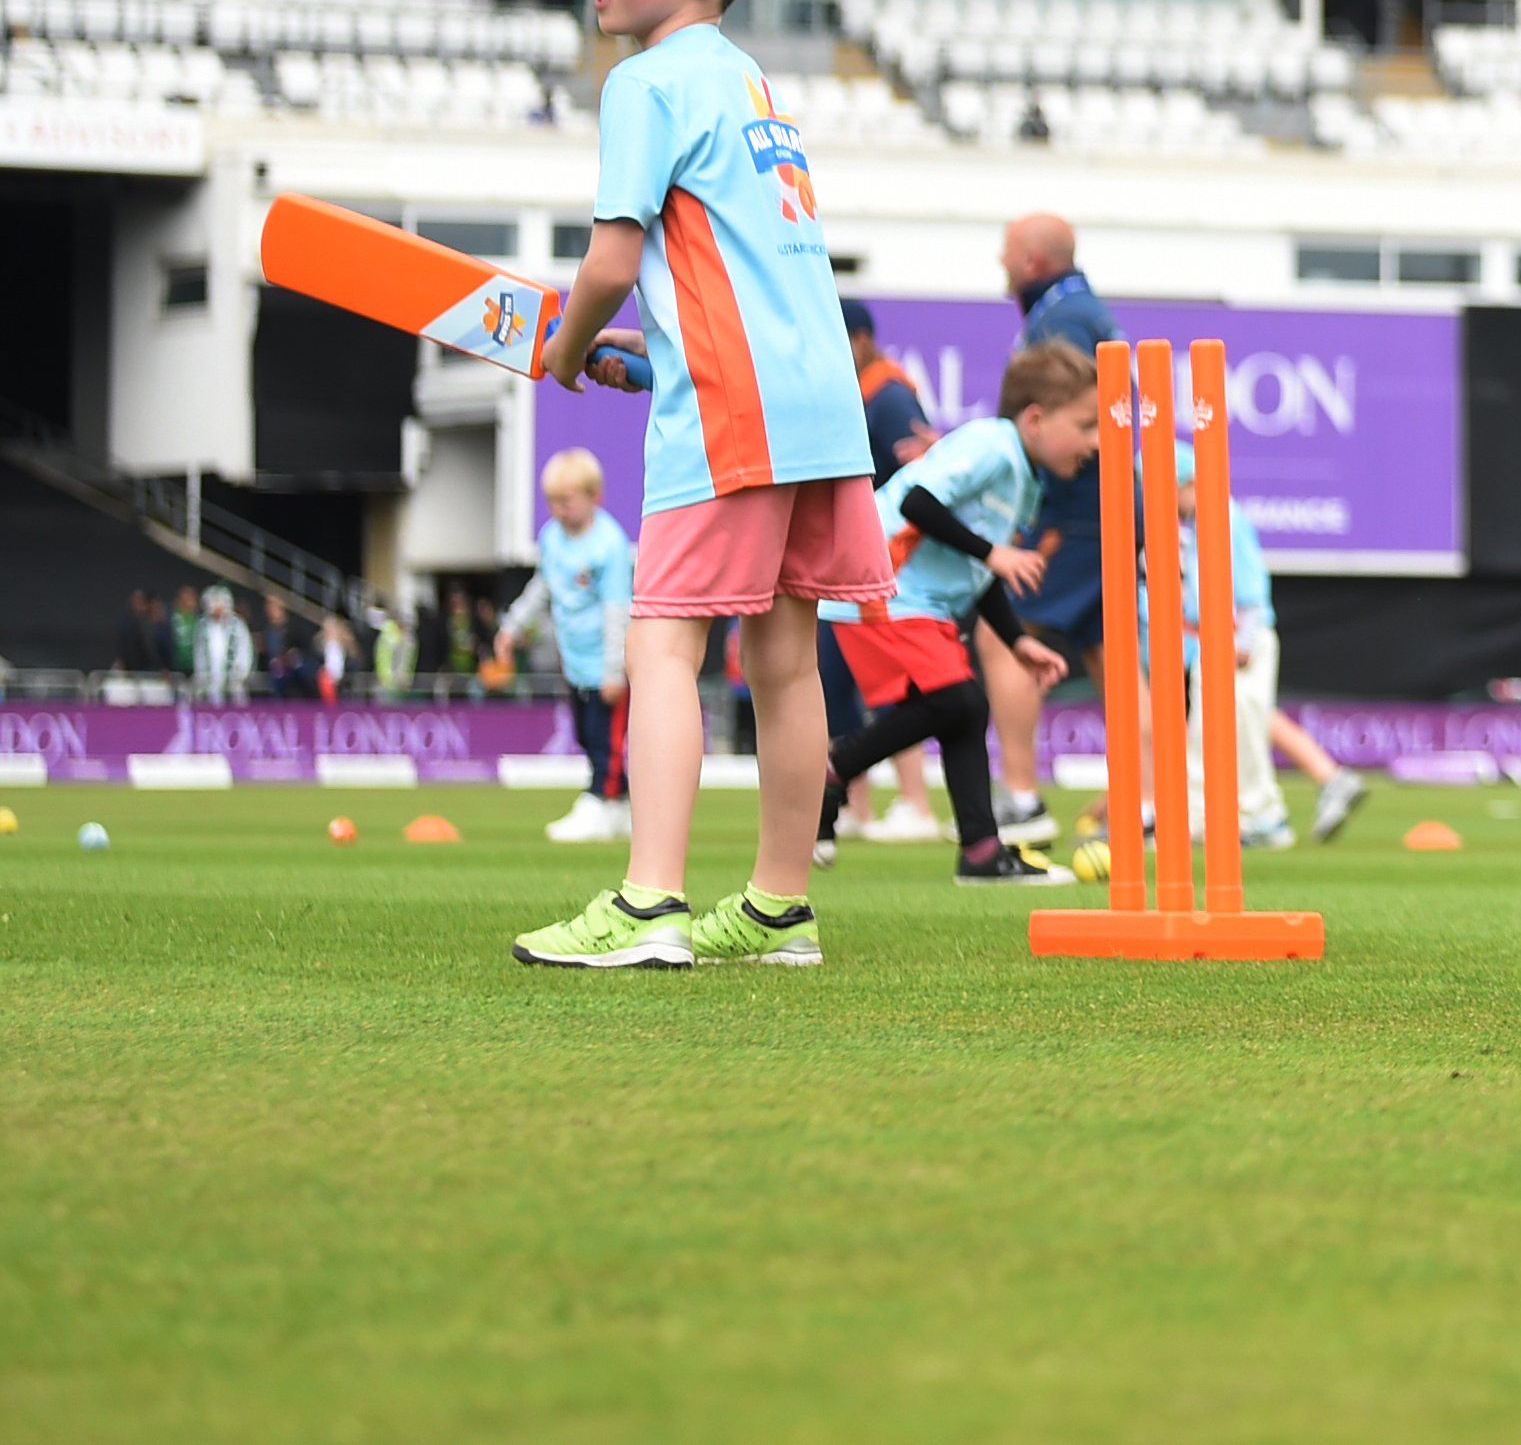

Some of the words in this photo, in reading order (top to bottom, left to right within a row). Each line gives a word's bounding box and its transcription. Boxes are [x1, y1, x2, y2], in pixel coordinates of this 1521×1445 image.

[748, 124, 773, 154] ALL
[195, 711, 304, 763] ROYAL
[313, 711, 472, 765] LONDON
